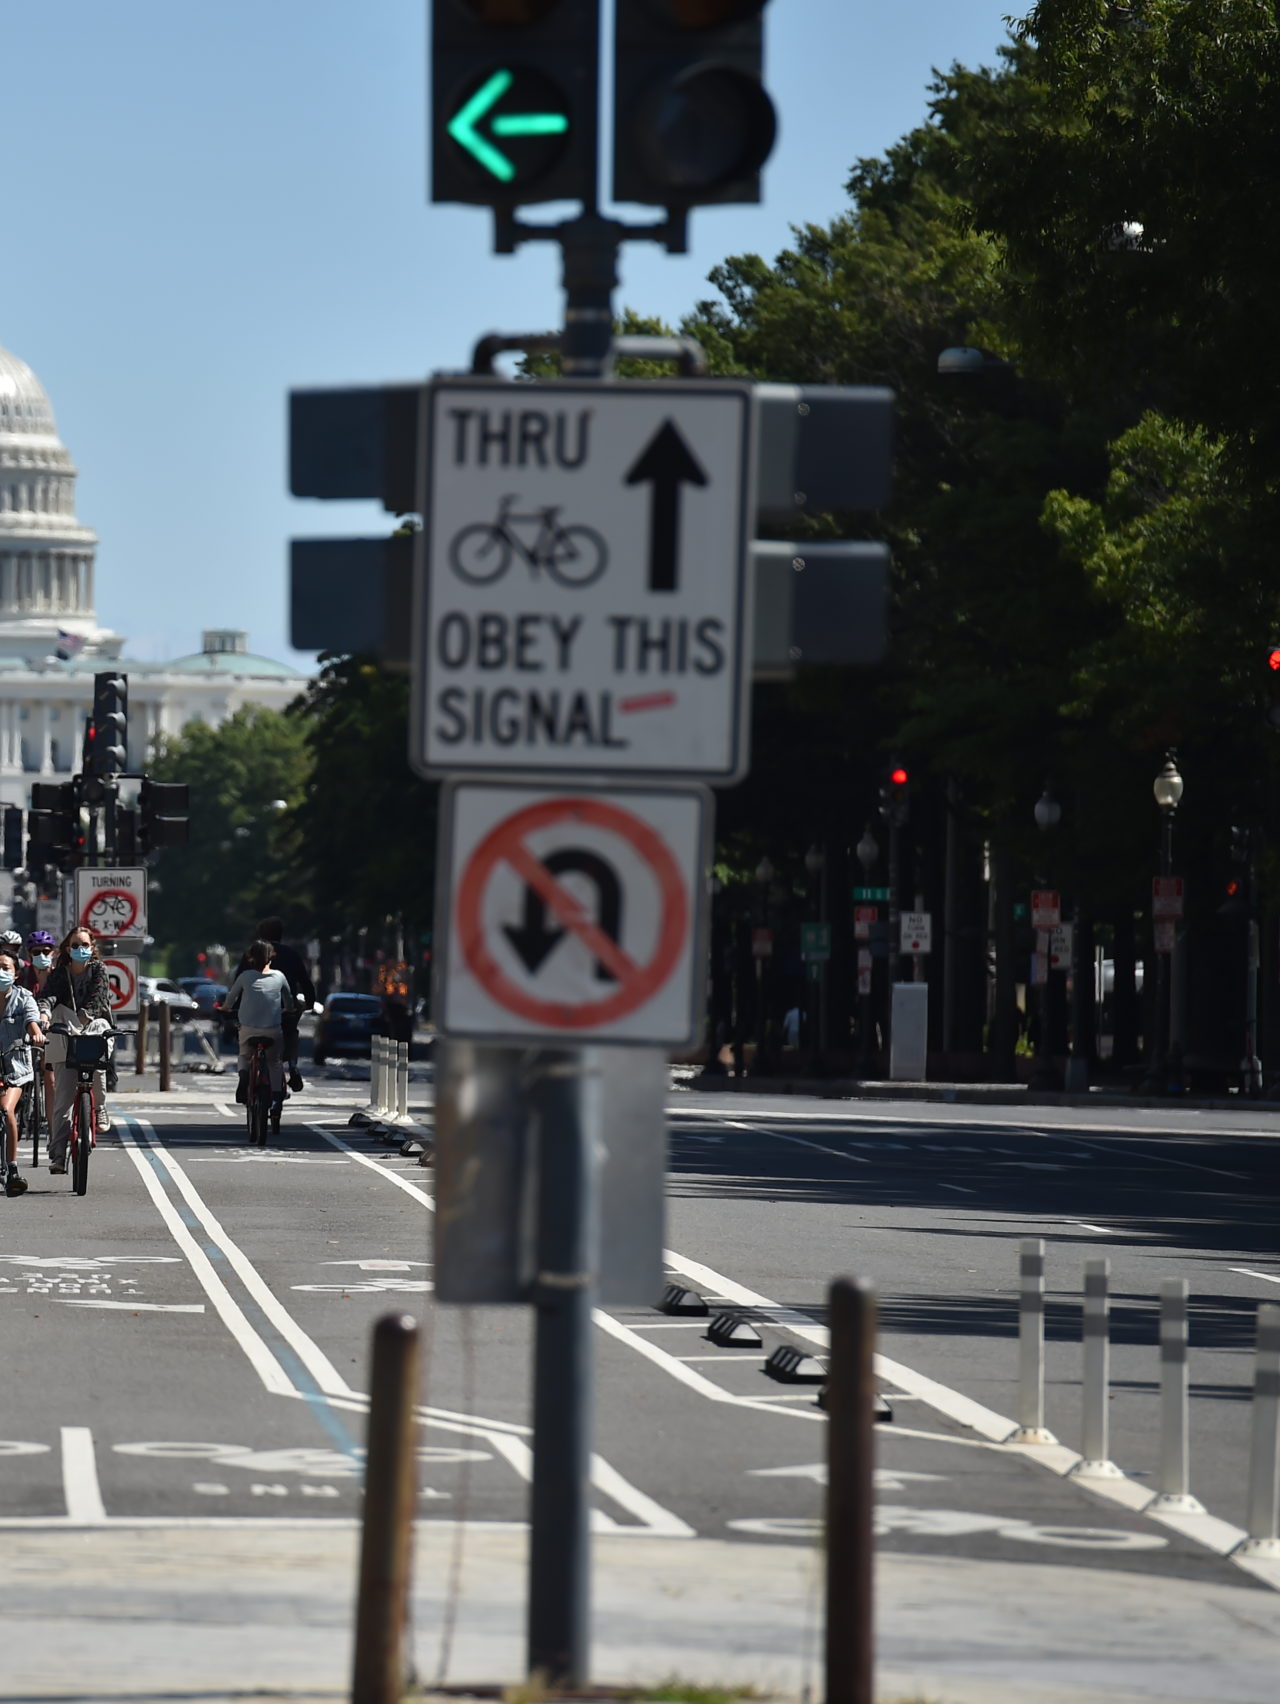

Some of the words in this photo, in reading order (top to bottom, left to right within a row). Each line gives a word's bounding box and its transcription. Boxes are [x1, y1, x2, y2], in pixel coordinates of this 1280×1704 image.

[449, 407, 594, 469] THRU
[437, 611, 582, 673] OBEY
[607, 614, 726, 677] THIS
[436, 686, 629, 749] SIGNAL
[92, 876, 132, 888] TURNING
